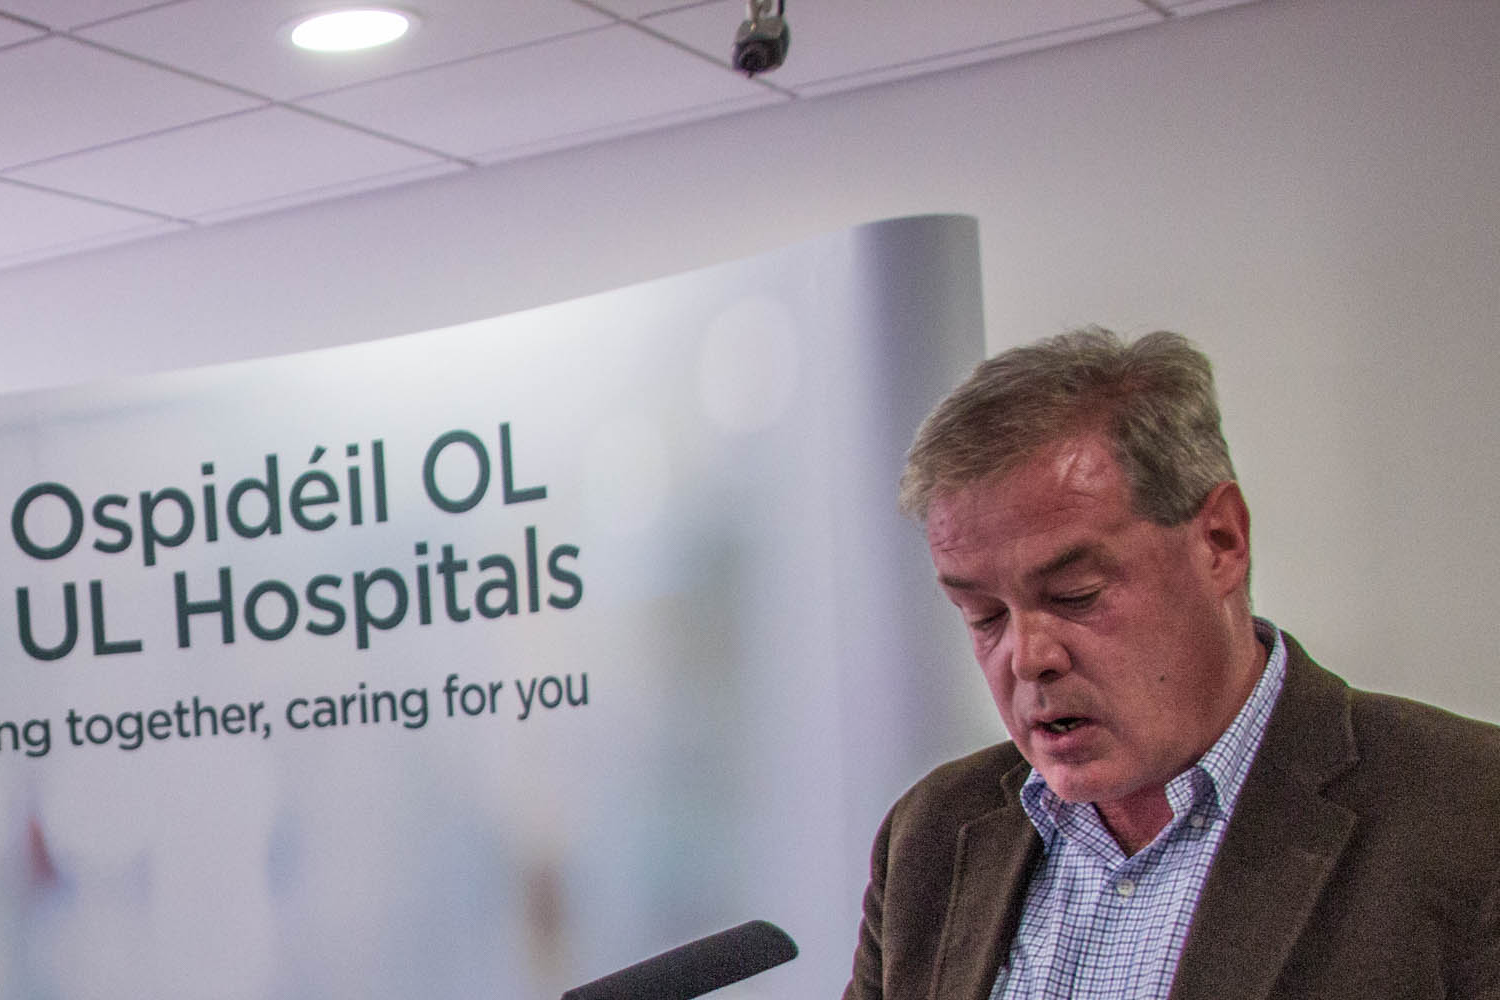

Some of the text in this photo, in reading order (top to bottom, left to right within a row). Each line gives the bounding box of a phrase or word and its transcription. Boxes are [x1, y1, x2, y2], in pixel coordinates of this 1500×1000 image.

[11, 422, 548, 566] Ospidéil OL
[16, 526, 585, 661] UL Hospitals
[65, 694, 272, 751] together,
[285, 680, 430, 730] caring
[443, 673, 503, 717] for
[515, 671, 591, 714] you
